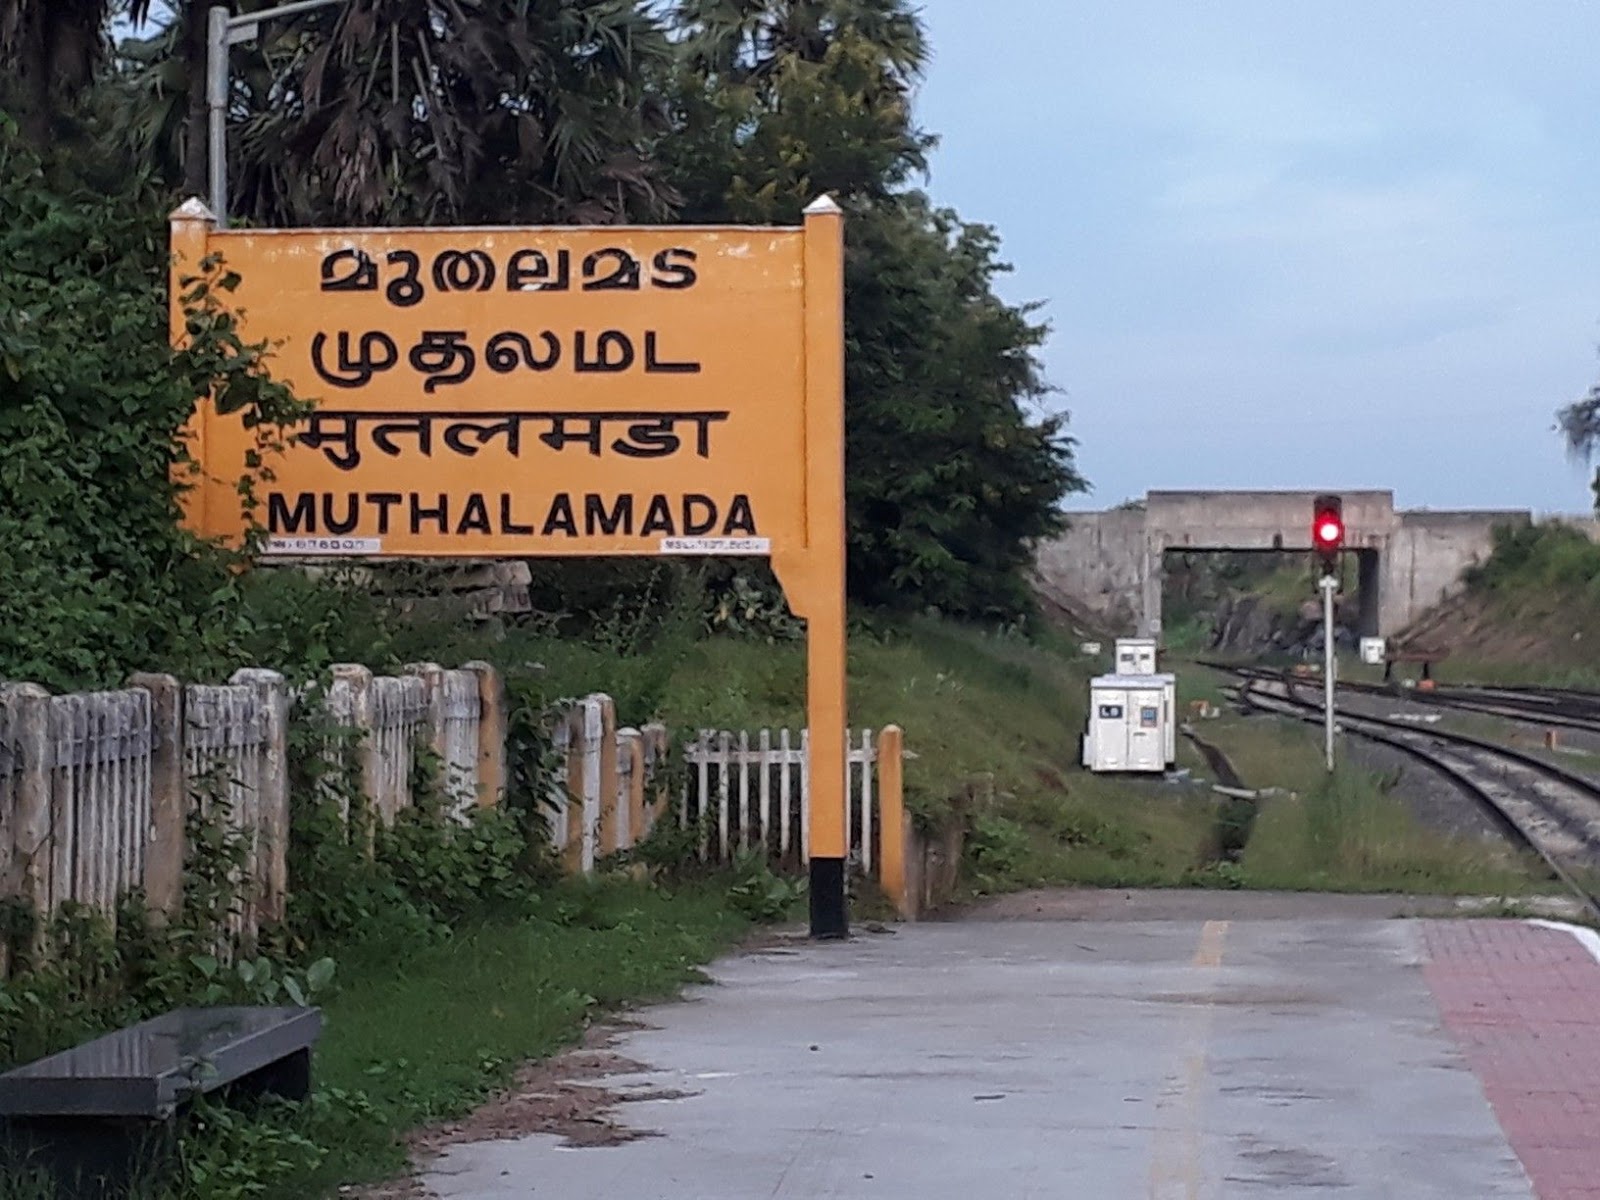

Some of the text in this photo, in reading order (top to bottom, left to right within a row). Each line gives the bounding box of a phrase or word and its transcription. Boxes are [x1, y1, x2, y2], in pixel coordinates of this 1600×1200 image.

[321, 248, 697, 306] മുതലമട
[312, 331, 701, 393] முதலமட
[299, 410, 730, 471] मुतलमडा
[268, 493, 757, 536] MUTHALAMADA
